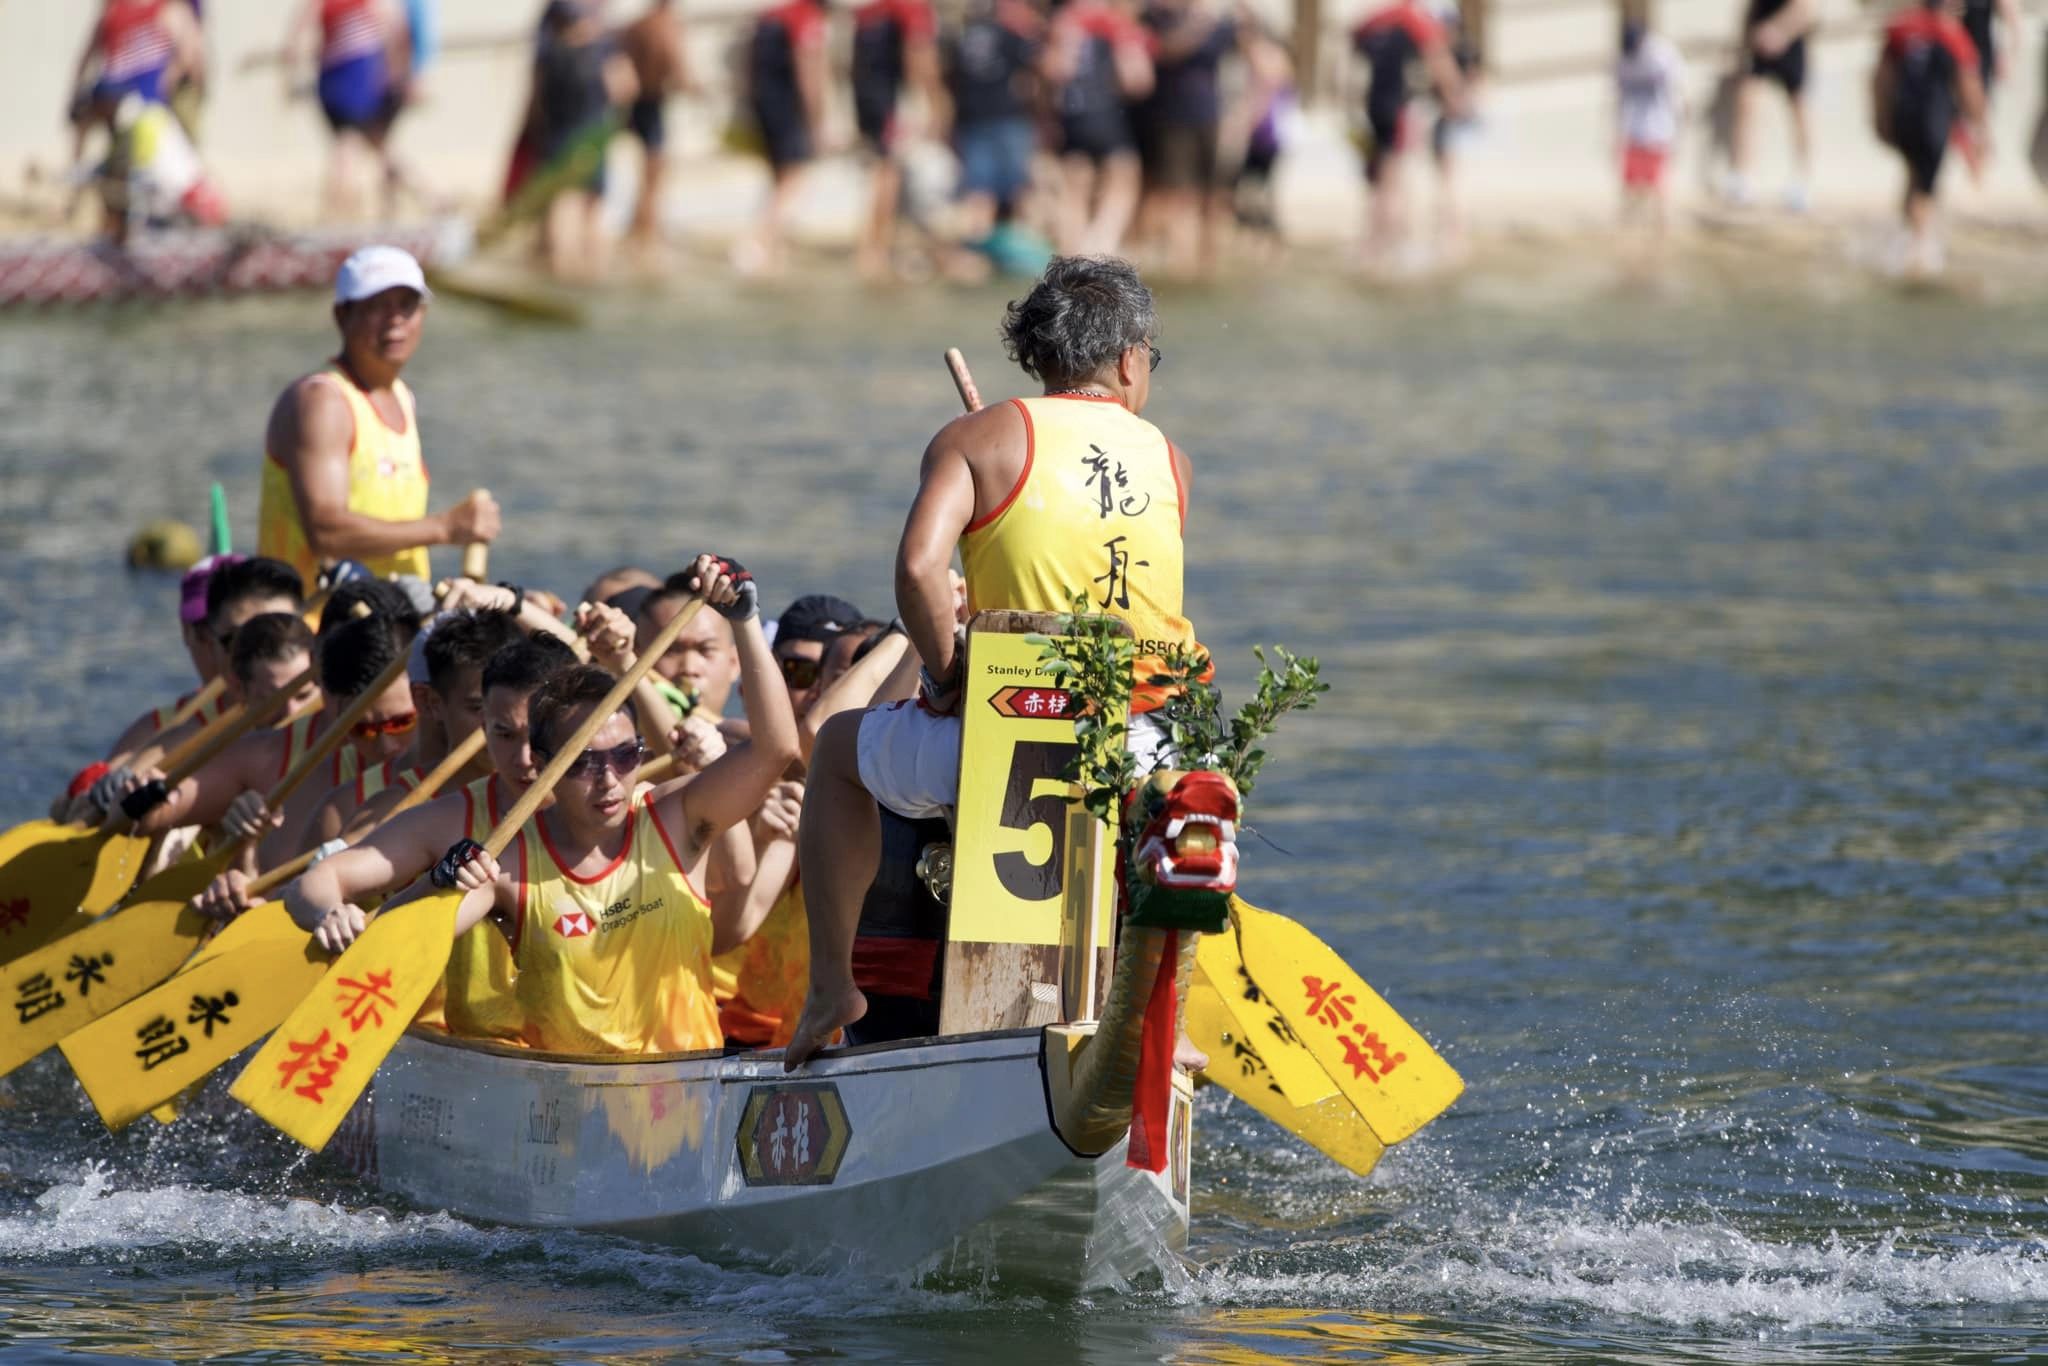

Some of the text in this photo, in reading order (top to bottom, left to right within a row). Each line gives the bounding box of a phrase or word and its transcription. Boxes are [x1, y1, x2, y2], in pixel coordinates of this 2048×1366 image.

[987, 664, 1031, 677] Stanley
[1024, 692, 1068, 714] 赤柱
[993, 740, 1081, 901] 5
[600, 898, 632, 920] HSBC
[277, 968, 397, 1104] 赤柱
[1302, 975, 1407, 1084] 赤柱
